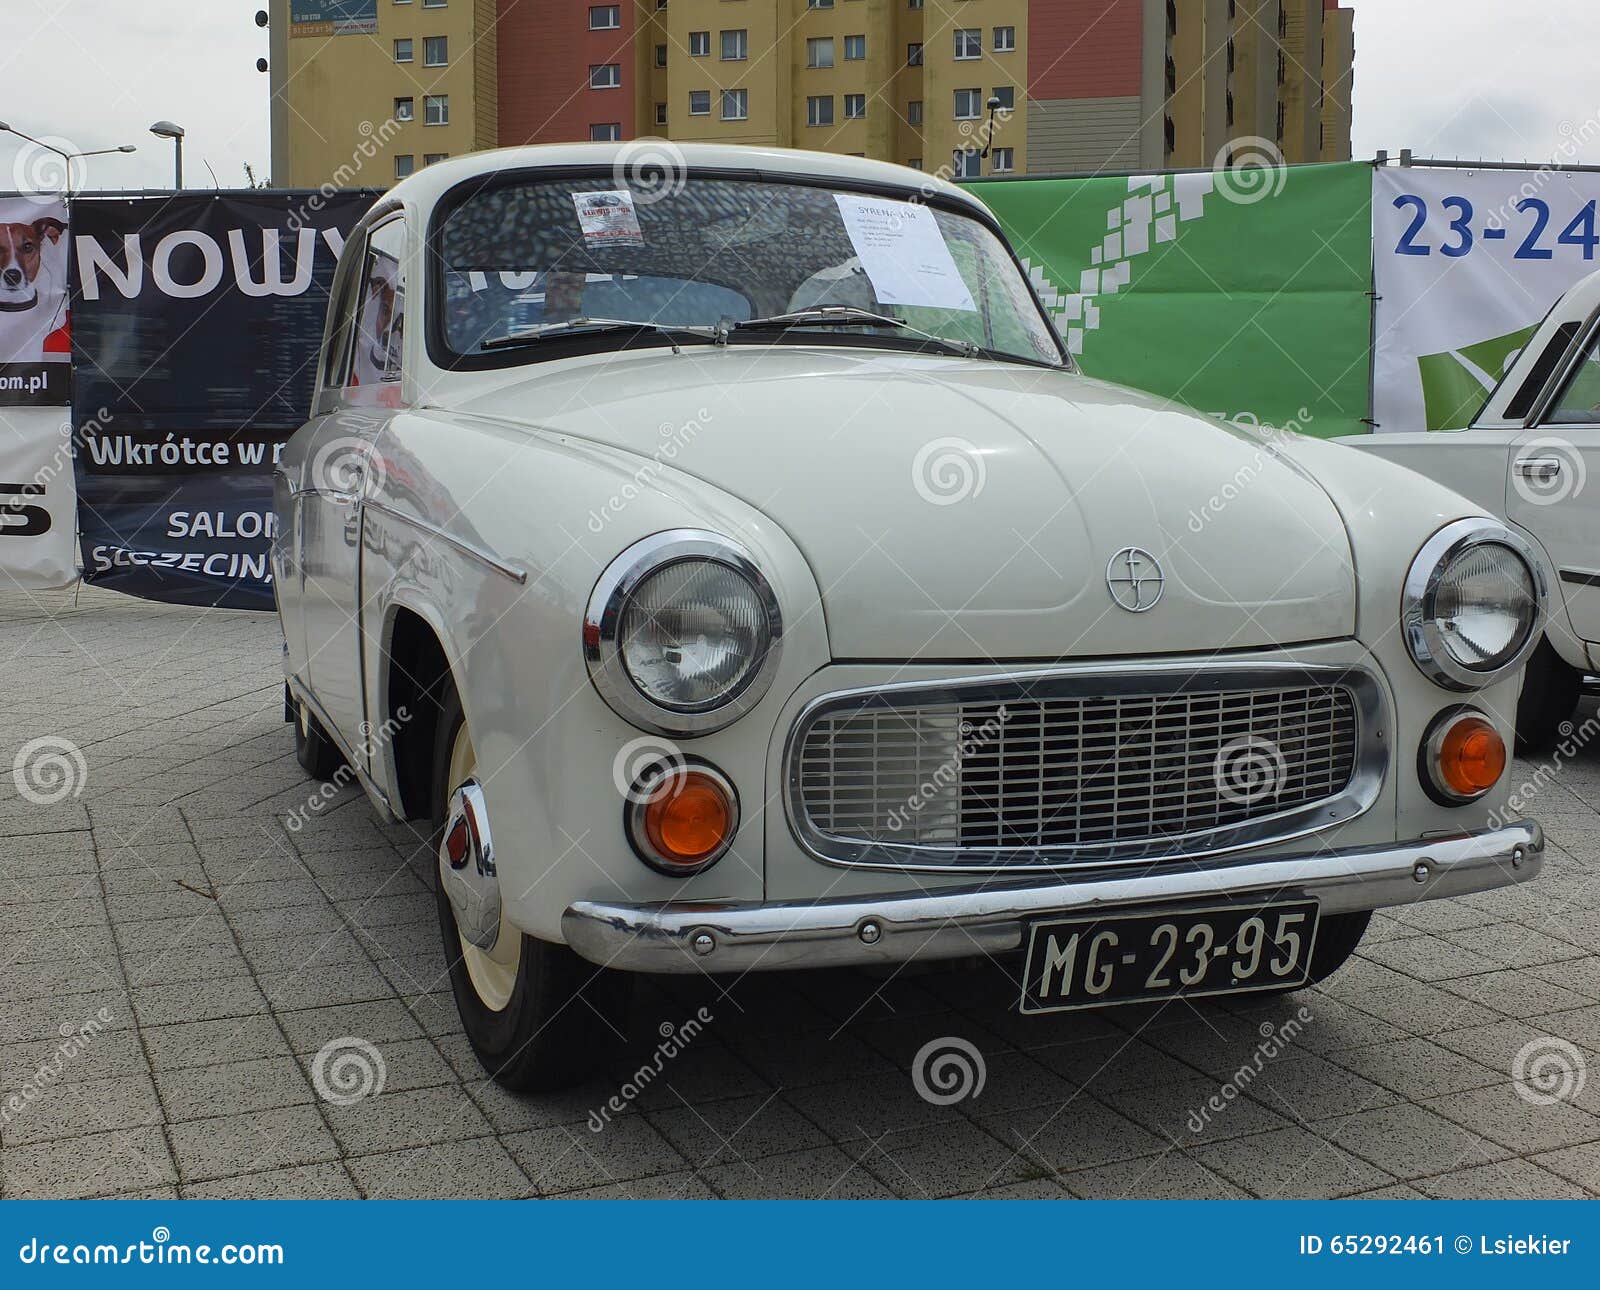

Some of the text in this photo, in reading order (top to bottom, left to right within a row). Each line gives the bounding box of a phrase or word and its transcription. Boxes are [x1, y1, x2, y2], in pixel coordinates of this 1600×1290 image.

[1392, 194, 1600, 260] 23-24
[88, 432, 229, 465] Wkrótce
[237, 443, 265, 465] w
[1038, 912, 1306, 998] MG-23-95
